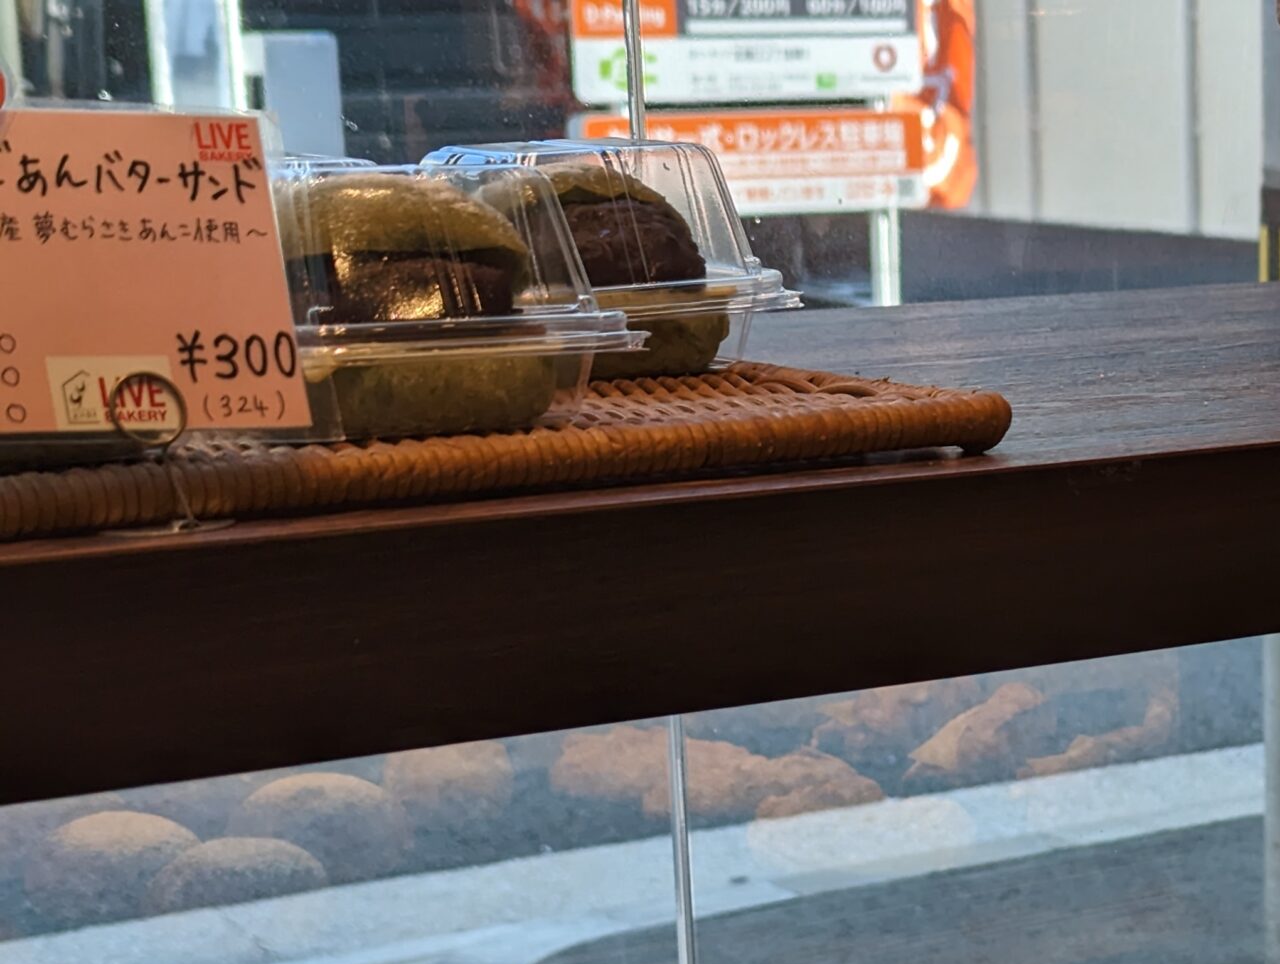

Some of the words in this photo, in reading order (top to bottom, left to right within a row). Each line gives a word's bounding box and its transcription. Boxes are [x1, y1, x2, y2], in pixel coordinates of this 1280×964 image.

[194, 122, 252, 150] LIVE
[0, 139, 262, 203] あんバターサンド
[177, 331, 297, 383] ¥300
[98, 376, 167, 408] LIVE
[203, 391, 286, 421] (324)
